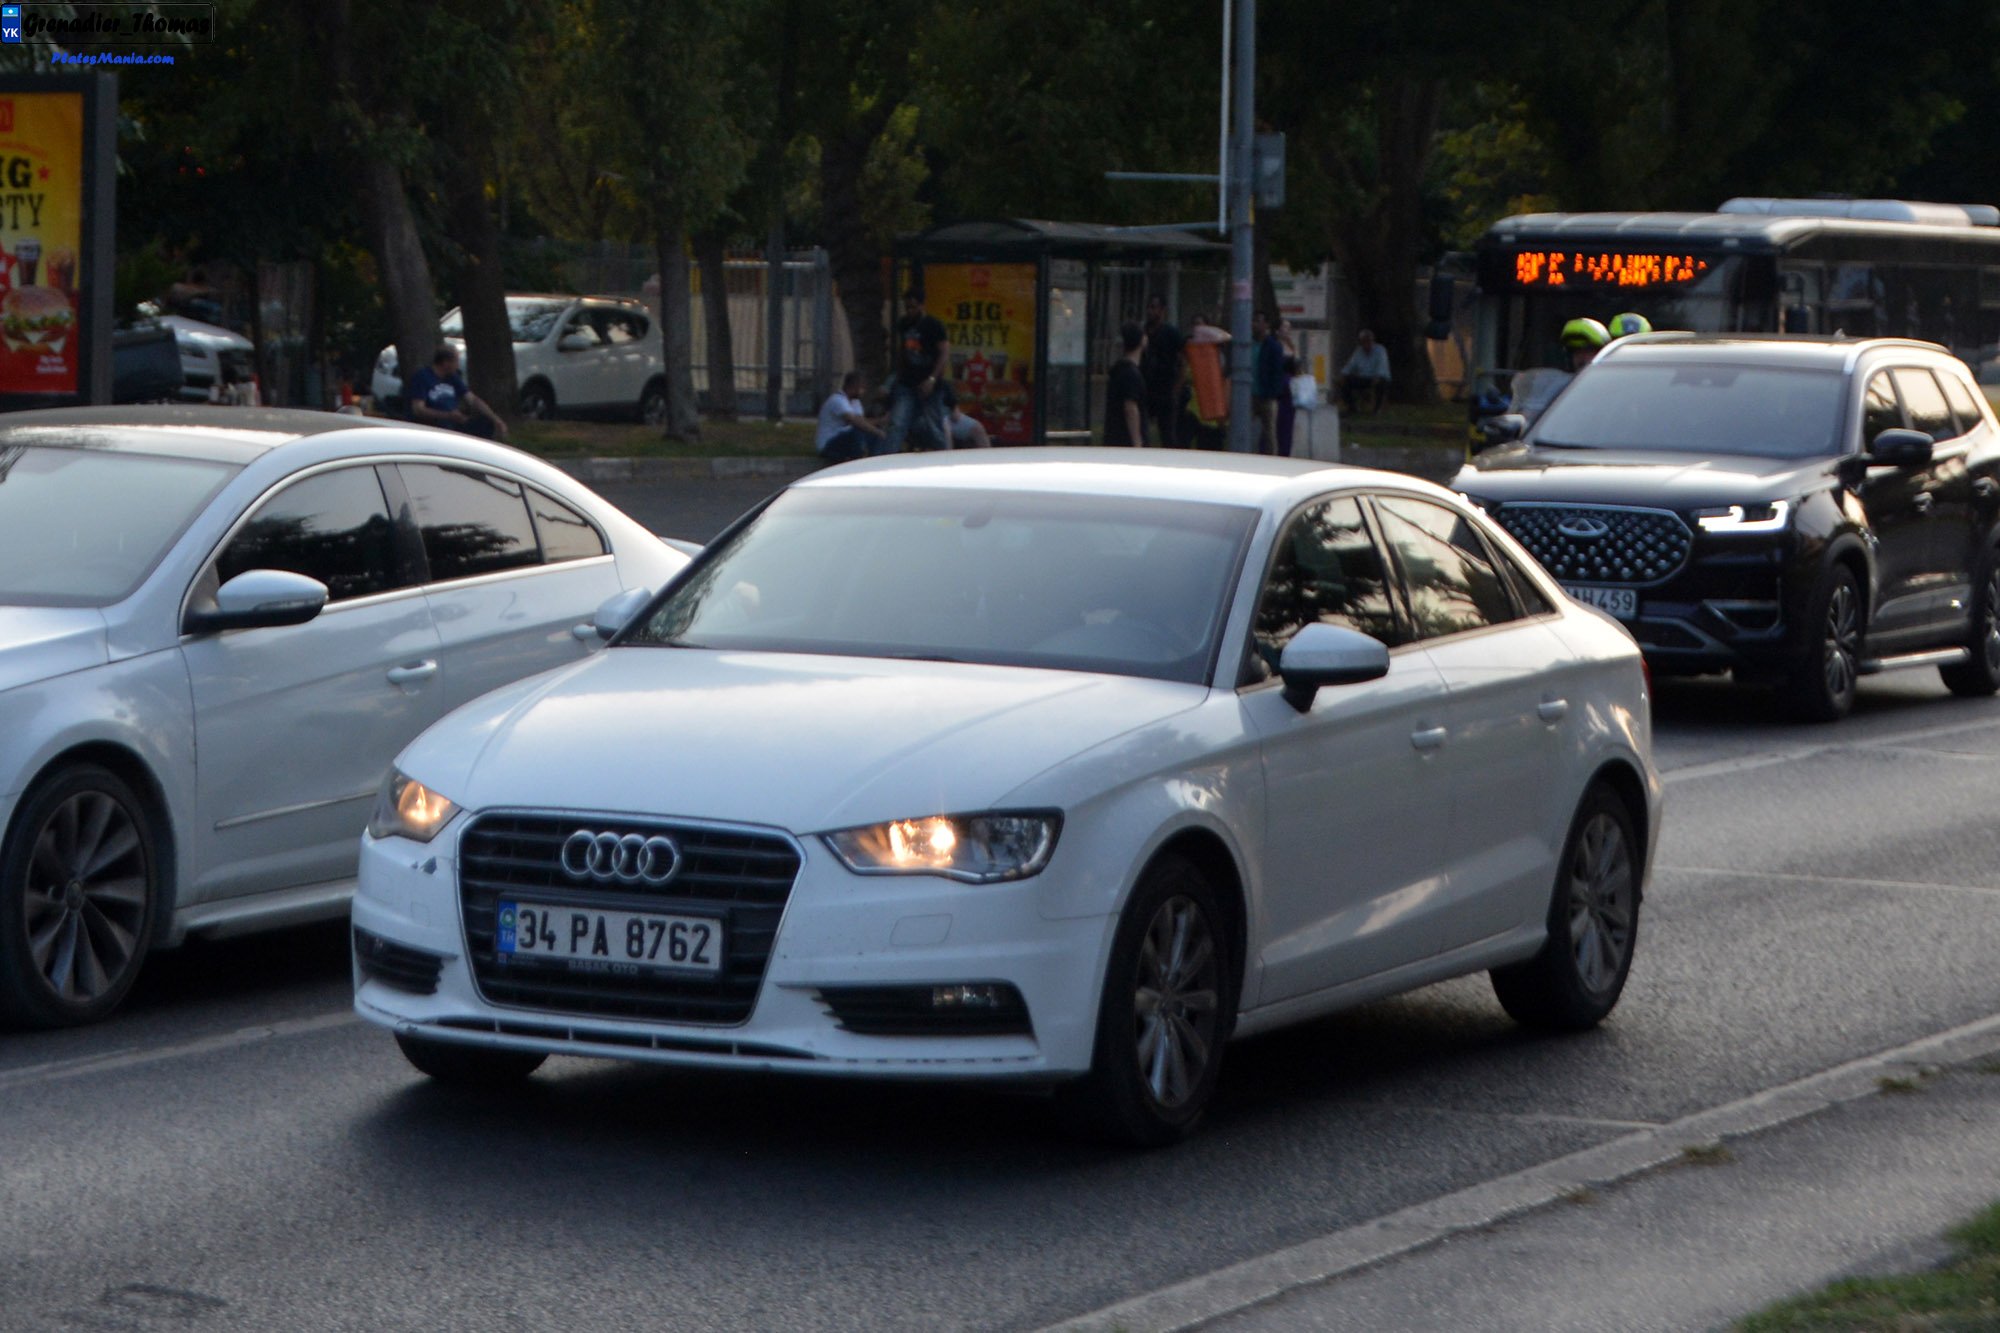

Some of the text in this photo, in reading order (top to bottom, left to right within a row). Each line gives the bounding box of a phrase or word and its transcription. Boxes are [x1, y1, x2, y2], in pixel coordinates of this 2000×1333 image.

[957, 301, 1001, 321] BIG
[947, 323, 1011, 346] TASTY
[518, 909, 711, 965] 34 PA 8762
